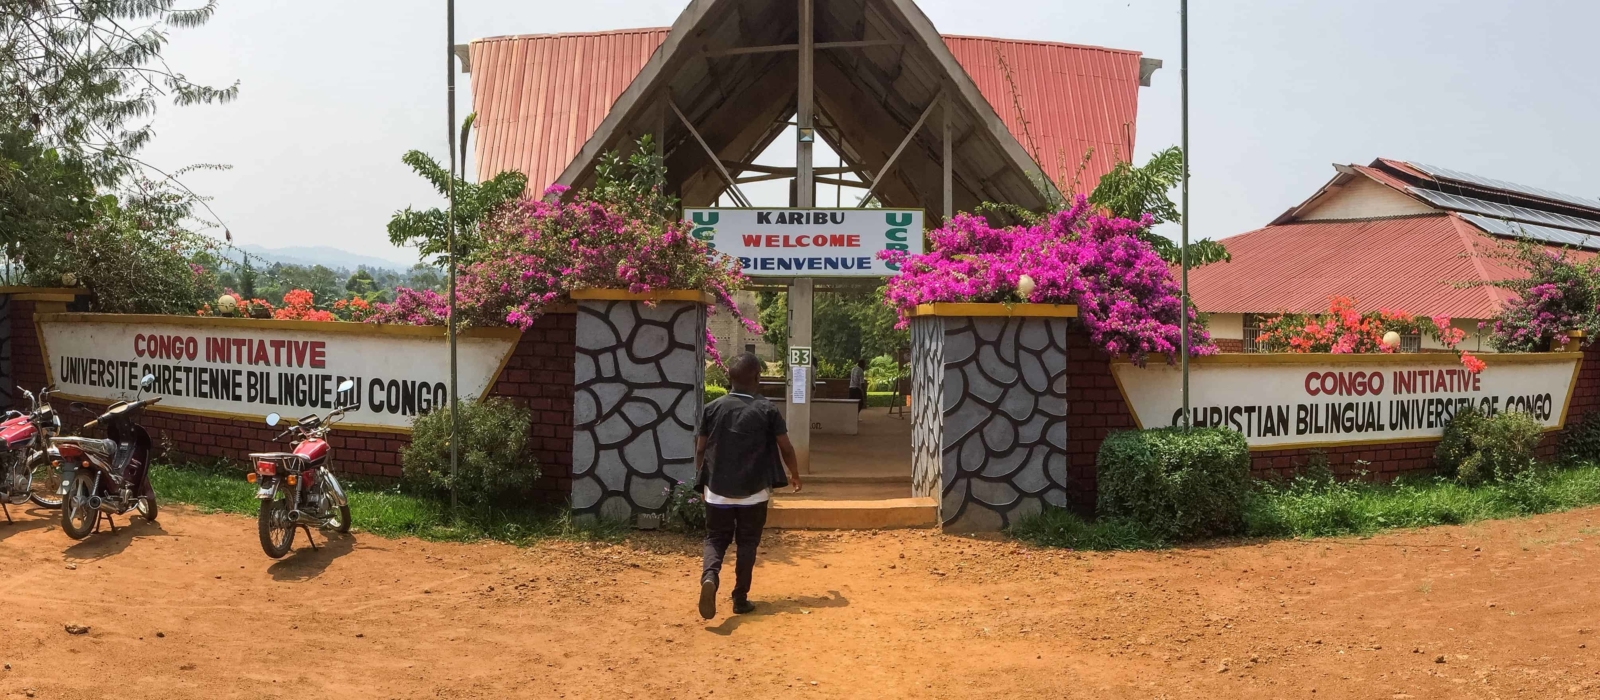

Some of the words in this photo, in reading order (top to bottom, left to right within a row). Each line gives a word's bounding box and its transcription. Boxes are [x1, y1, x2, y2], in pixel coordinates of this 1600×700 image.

[757, 212, 845, 225] KARIBU
[742, 234, 861, 248] WELCOME
[740, 257, 872, 270] BIENVENUE
[134, 333, 199, 361] CONGO
[206, 337, 326, 369] INITIATIVE
[791, 350, 809, 363] B3
[60, 356, 139, 391] UNIVERSITÉ
[142, 361, 243, 402] CHRÉTIENNE
[246, 371, 332, 409] BILINGUE
[336, 376, 361, 411] DU
[368, 378, 447, 416] CONGO
[1304, 371, 1384, 396] CONGO
[1392, 369, 1481, 395] INITIATIVE
[1296, 400, 1385, 435] BILINGUAL
[1480, 396, 1499, 419] OF
[1505, 392, 1552, 421] CONGO
